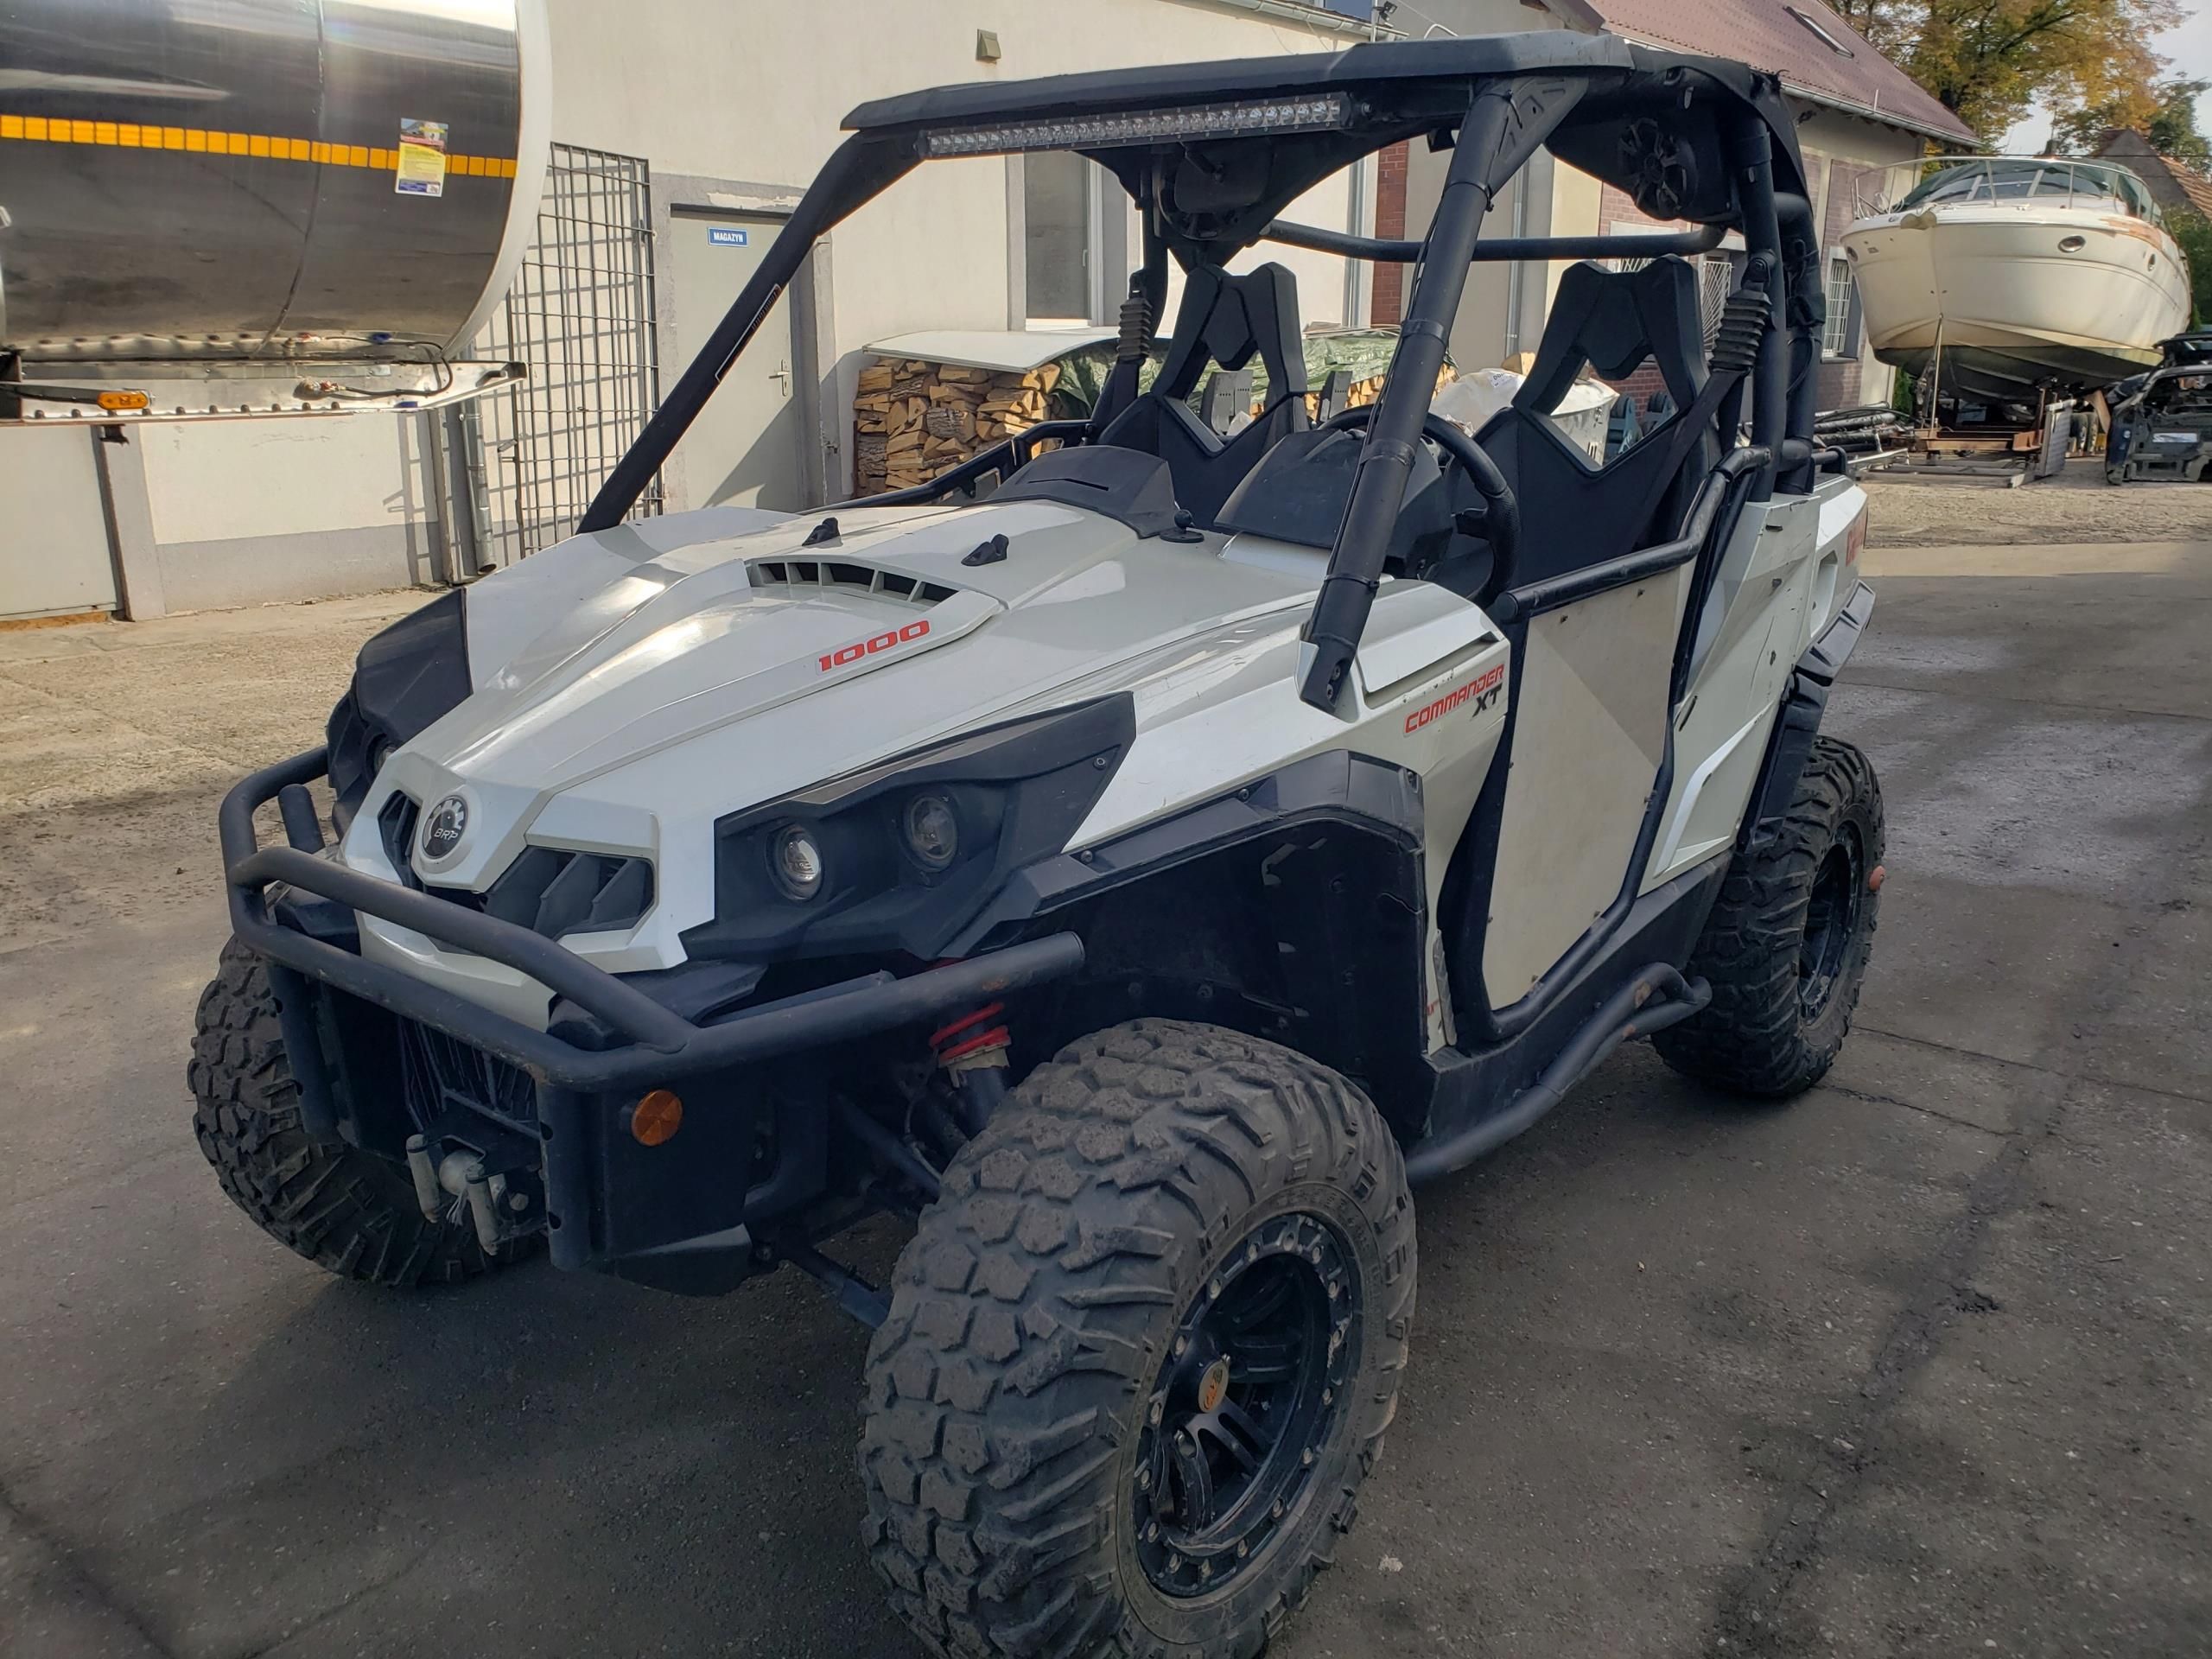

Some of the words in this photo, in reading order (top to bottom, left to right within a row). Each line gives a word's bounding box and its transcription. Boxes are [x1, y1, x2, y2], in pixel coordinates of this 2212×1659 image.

[714, 232, 743, 243] MAGAZYN
[818, 620, 931, 671] 1000
[1405, 663, 1505, 734] COMMANDER
[1471, 682, 1503, 718] XT
[434, 828, 458, 841] BRP
